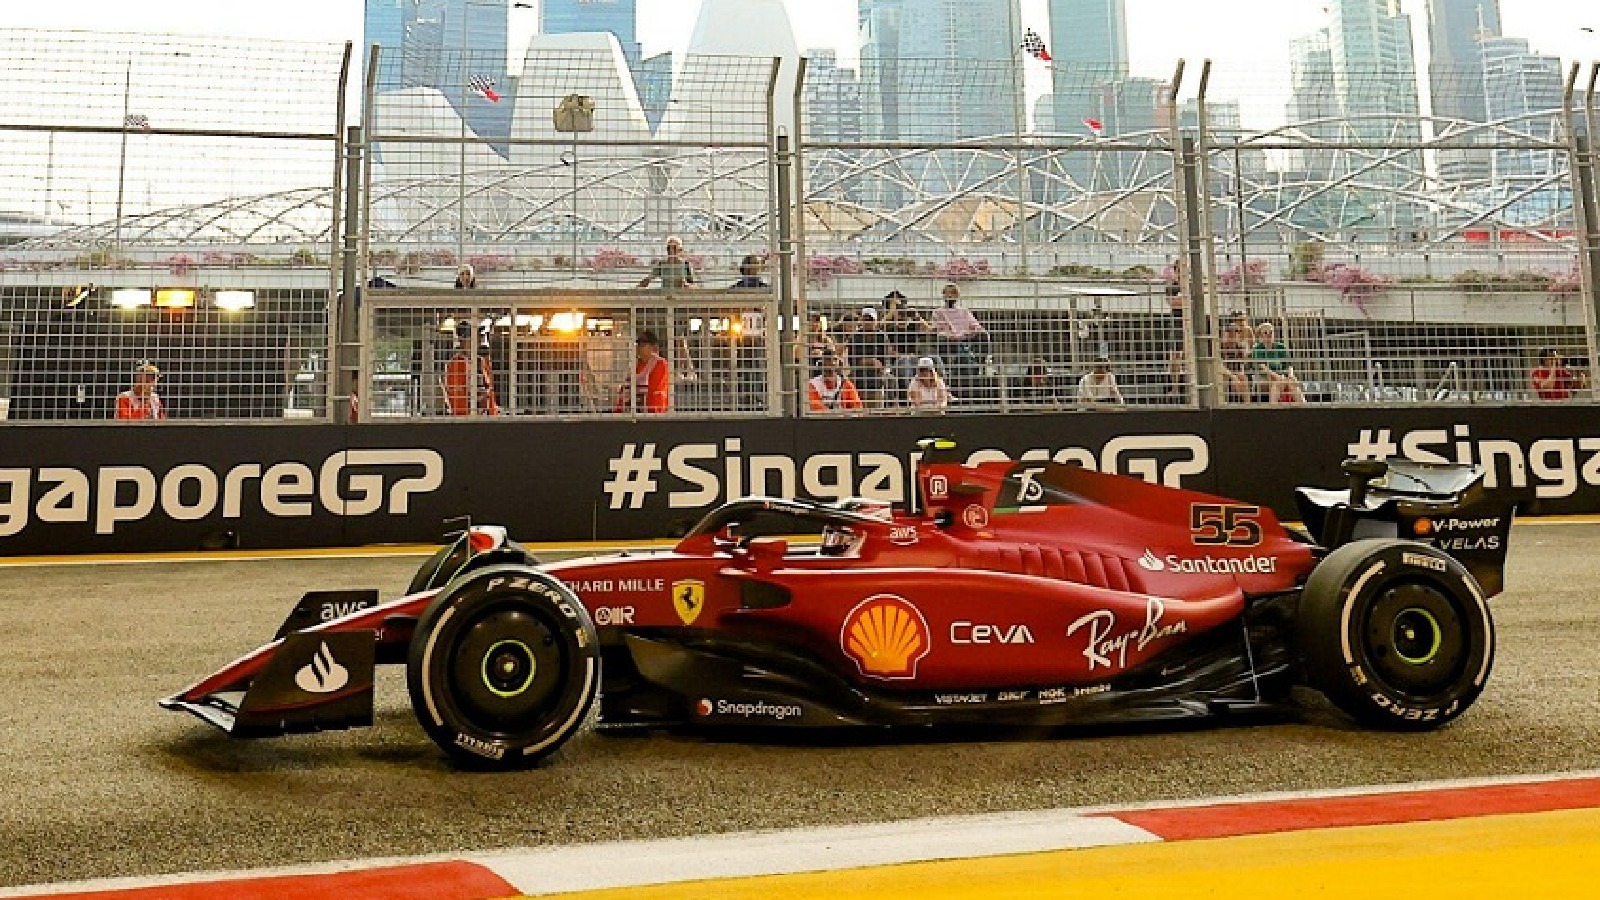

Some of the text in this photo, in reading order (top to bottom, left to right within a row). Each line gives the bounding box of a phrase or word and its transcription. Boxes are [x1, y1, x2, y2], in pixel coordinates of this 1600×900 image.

[603, 433, 1209, 513] #SingaGP
[1190, 501, 1263, 547] 55
[1432, 517, 1501, 532] V-Power
[1440, 536, 1499, 550] VELAS
[1165, 554, 1278, 573] Santander
[618, 578, 664, 592] MILLE
[717, 700, 802, 720] Snapdragon
